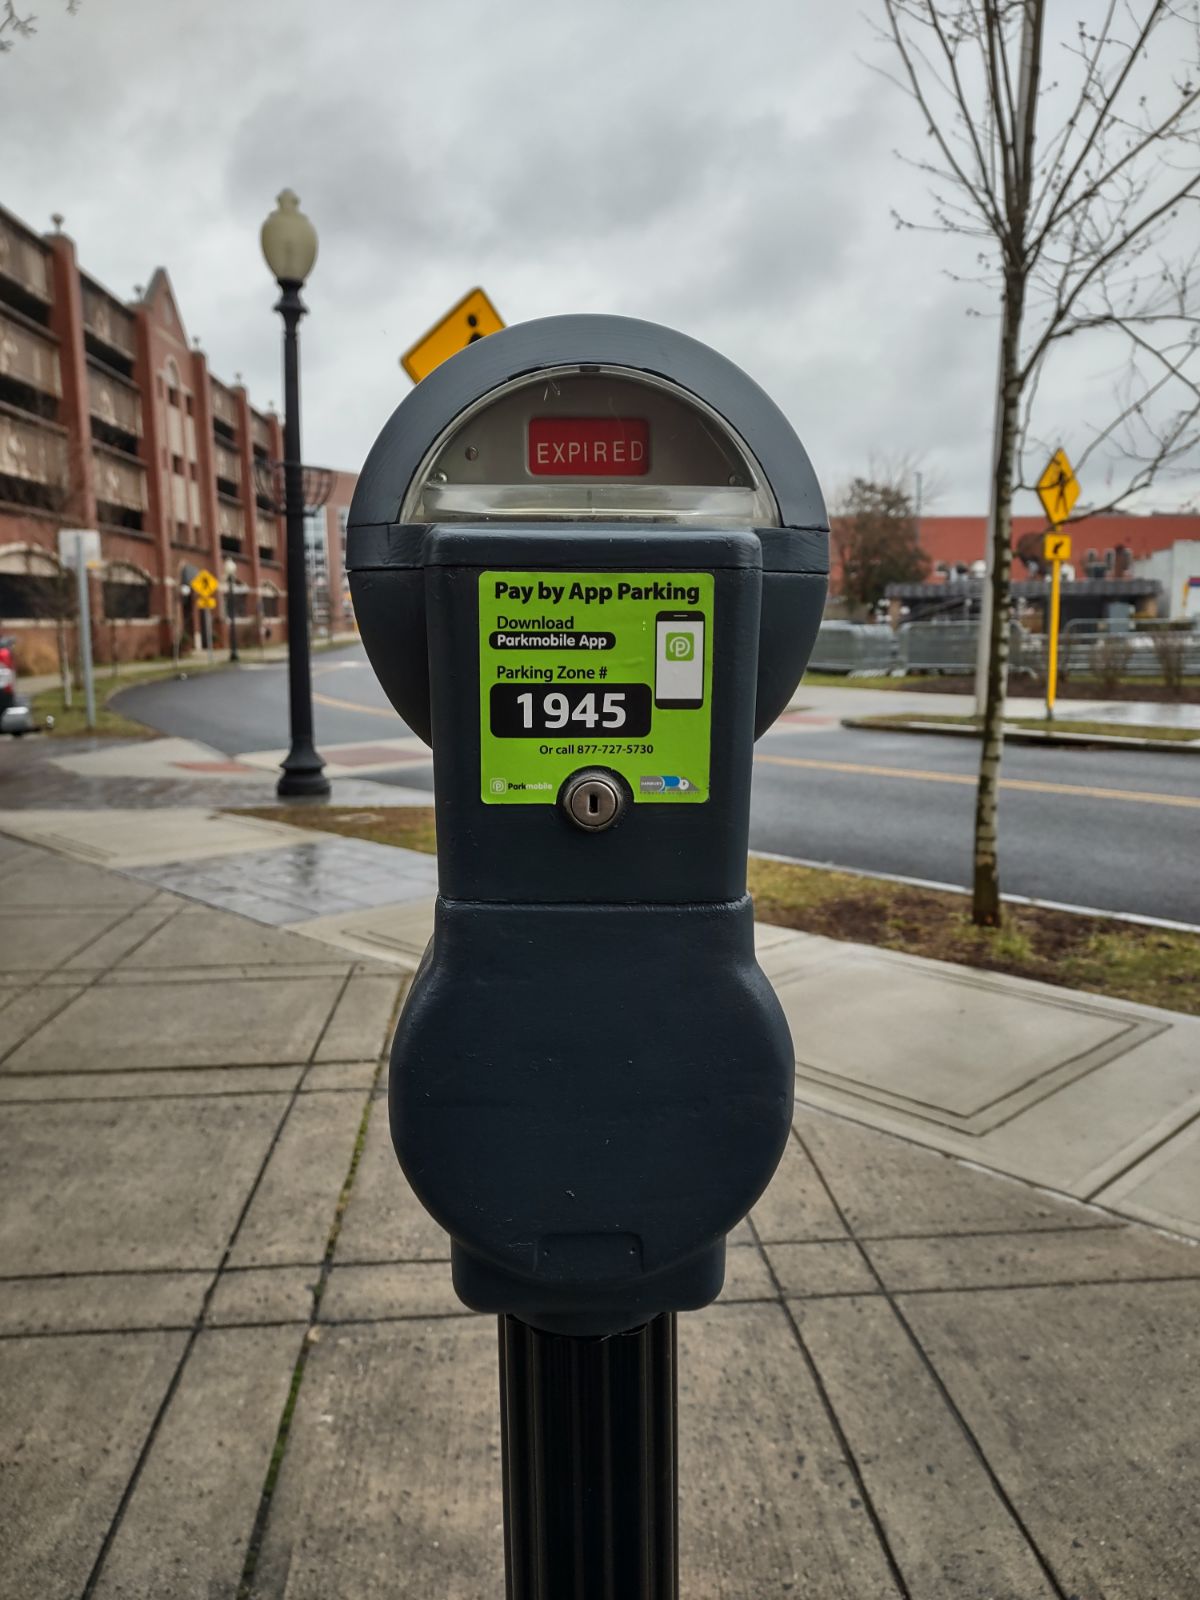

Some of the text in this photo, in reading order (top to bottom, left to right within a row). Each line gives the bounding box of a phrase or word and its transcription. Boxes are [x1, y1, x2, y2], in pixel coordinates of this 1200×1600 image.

[537, 441, 643, 464] EXPIRED
[494, 581, 700, 605] Pay by App Parking
[497, 616, 575, 630] Download
[497, 634, 608, 650] Parkmobile App
[497, 666, 608, 683] Parking Zone #
[517, 692, 627, 729] 1945
[539, 745, 654, 755] Or call 877-727-5730
